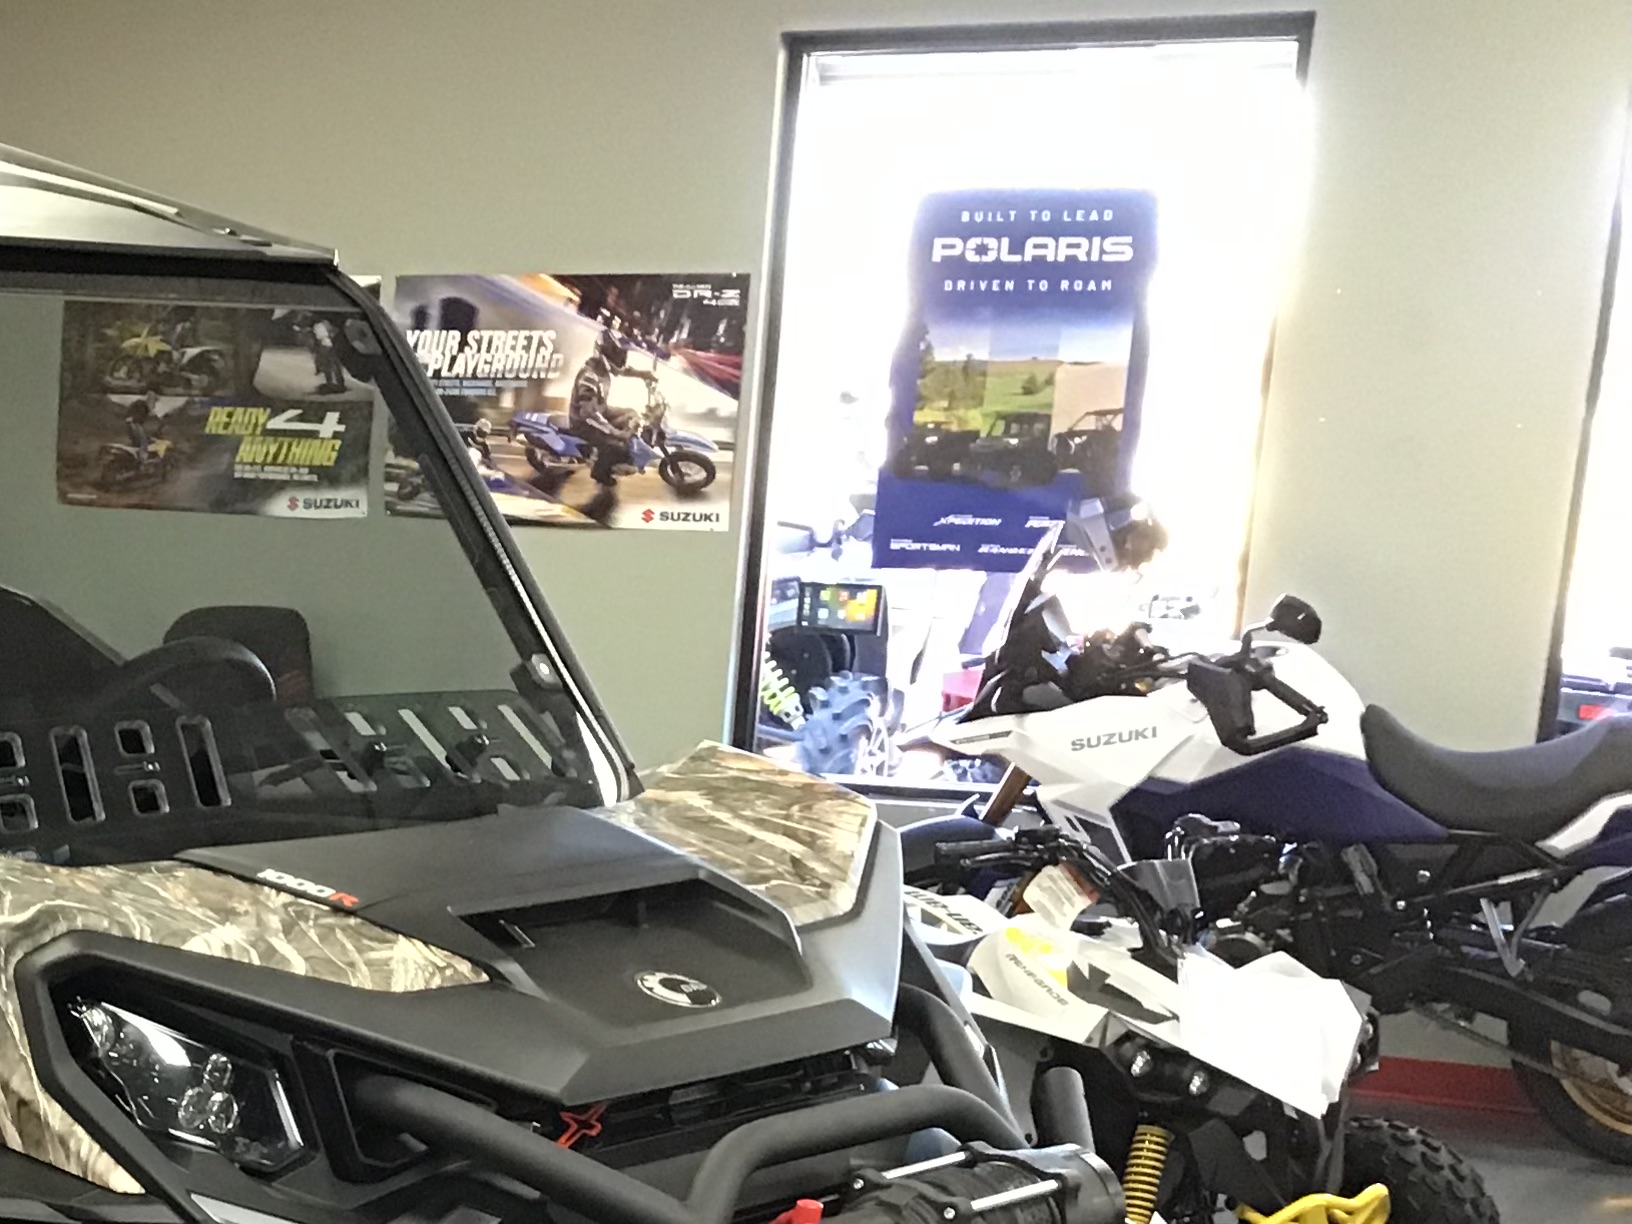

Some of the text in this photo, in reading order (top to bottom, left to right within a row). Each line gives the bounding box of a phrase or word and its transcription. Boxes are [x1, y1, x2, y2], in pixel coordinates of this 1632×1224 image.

[961, 209, 1114, 223] BUILT TO LEAD
[931, 235, 1134, 263] POLARIS
[944, 279, 1112, 292] DRIVEN TO ROAM
[406, 329, 462, 356] YOUR
[464, 329, 557, 360] STREETS
[426, 350, 566, 379] PLAYGROUND
[205, 406, 346, 438] READY 4
[235, 435, 342, 467] ANYTHING
[302, 497, 360, 510] SUZUKI
[659, 511, 720, 523] SUZUKI
[1070, 725, 1158, 752] SUZUKI
